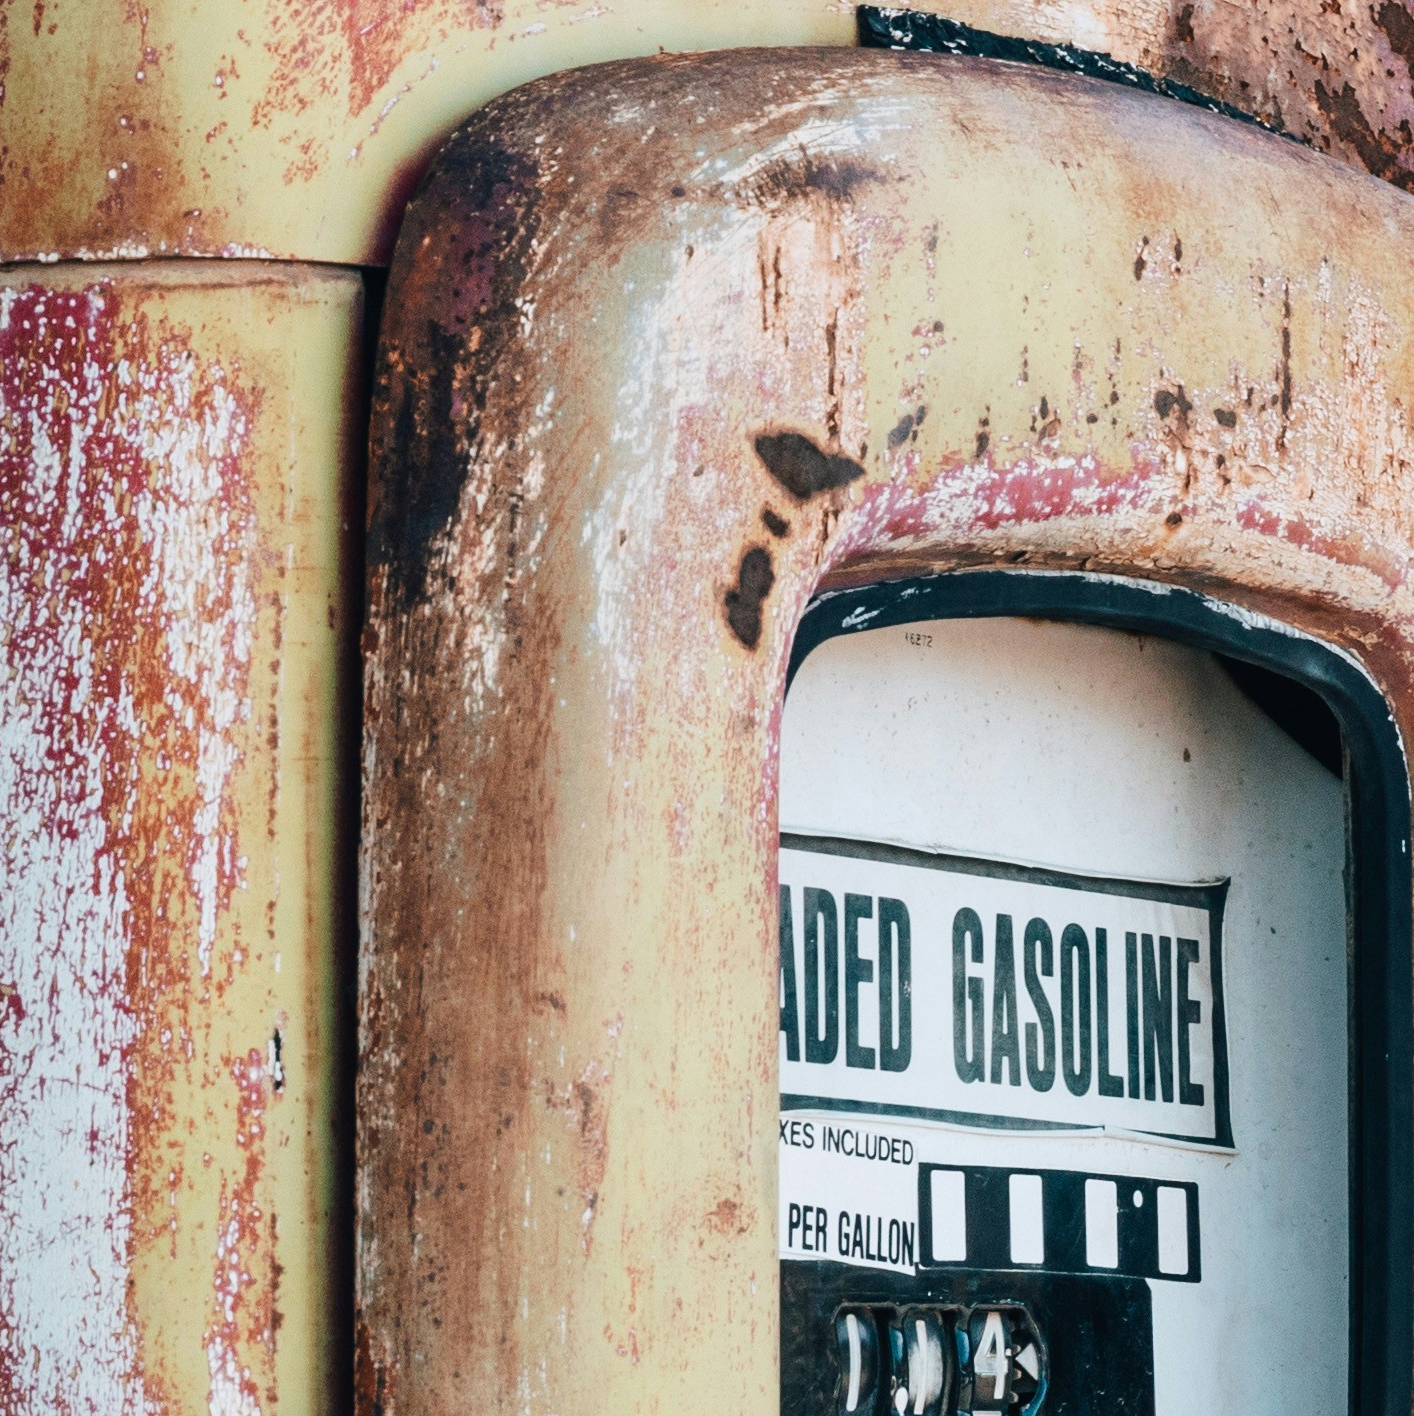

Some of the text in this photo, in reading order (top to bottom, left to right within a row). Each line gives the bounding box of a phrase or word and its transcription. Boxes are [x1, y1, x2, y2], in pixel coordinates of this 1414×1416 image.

[951, 906, 1205, 1107] GASOLINE
[822, 1126, 914, 1165] INCLUDED
[788, 1202, 915, 1267] PER GALLON
